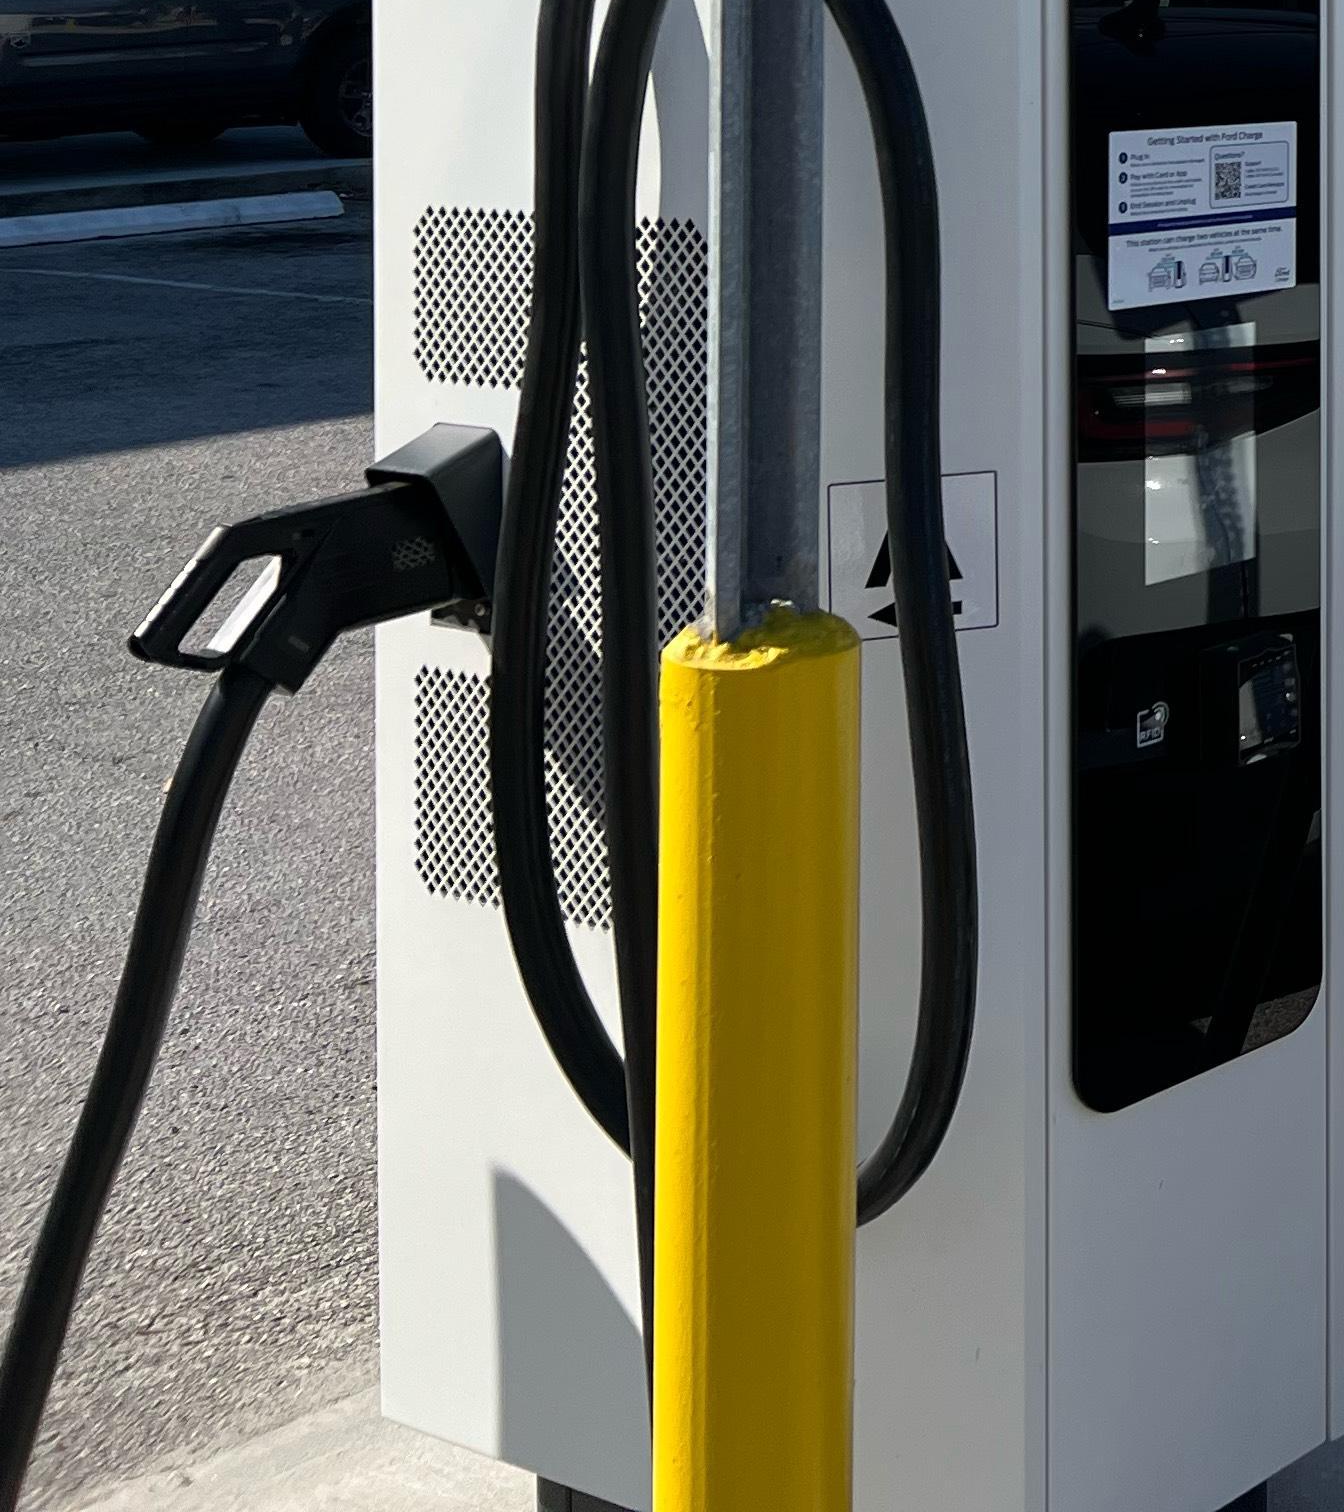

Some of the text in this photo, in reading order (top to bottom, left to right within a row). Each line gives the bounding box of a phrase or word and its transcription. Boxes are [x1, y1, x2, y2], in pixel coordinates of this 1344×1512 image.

[1147, 131, 1263, 146] Getting Started with Ford Charge
[1126, 240, 1140, 248] This
[1175, 234, 1195, 243] charge
